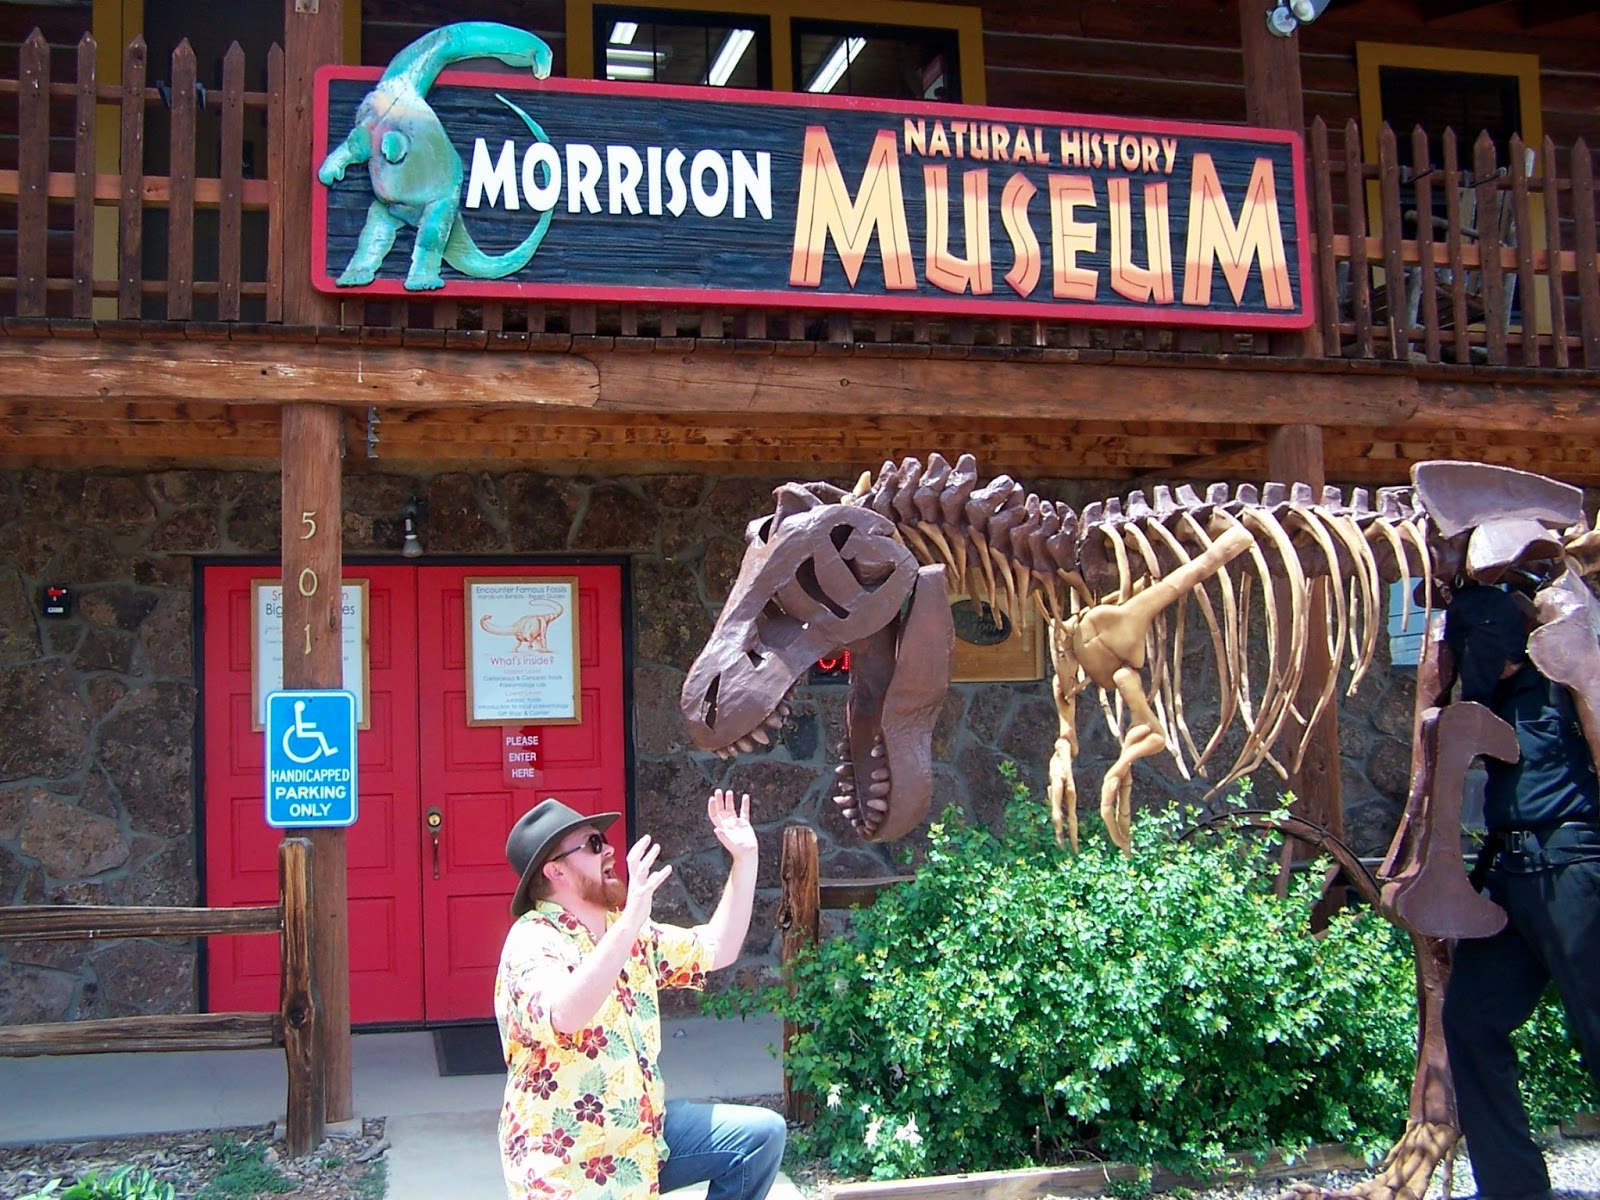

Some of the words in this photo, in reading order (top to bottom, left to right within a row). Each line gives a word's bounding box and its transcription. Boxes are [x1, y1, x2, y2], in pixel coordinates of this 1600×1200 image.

[903, 117, 1050, 165] NATURAL
[1059, 129, 1178, 175] HISTORY
[465, 137, 774, 220] MORRISON
[476, 586, 514, 594] Encounter
[546, 585, 567, 593] Fossils
[490, 656, 521, 665] What's
[523, 656, 554, 665] inside?
[506, 736, 539, 746] PLEASE
[509, 752, 537, 762] ENTER
[271, 768, 351, 783] HANDICAPPED
[511, 767, 535, 778] HERE
[275, 785, 347, 800] PARKING
[289, 802, 332, 817] ONLY
